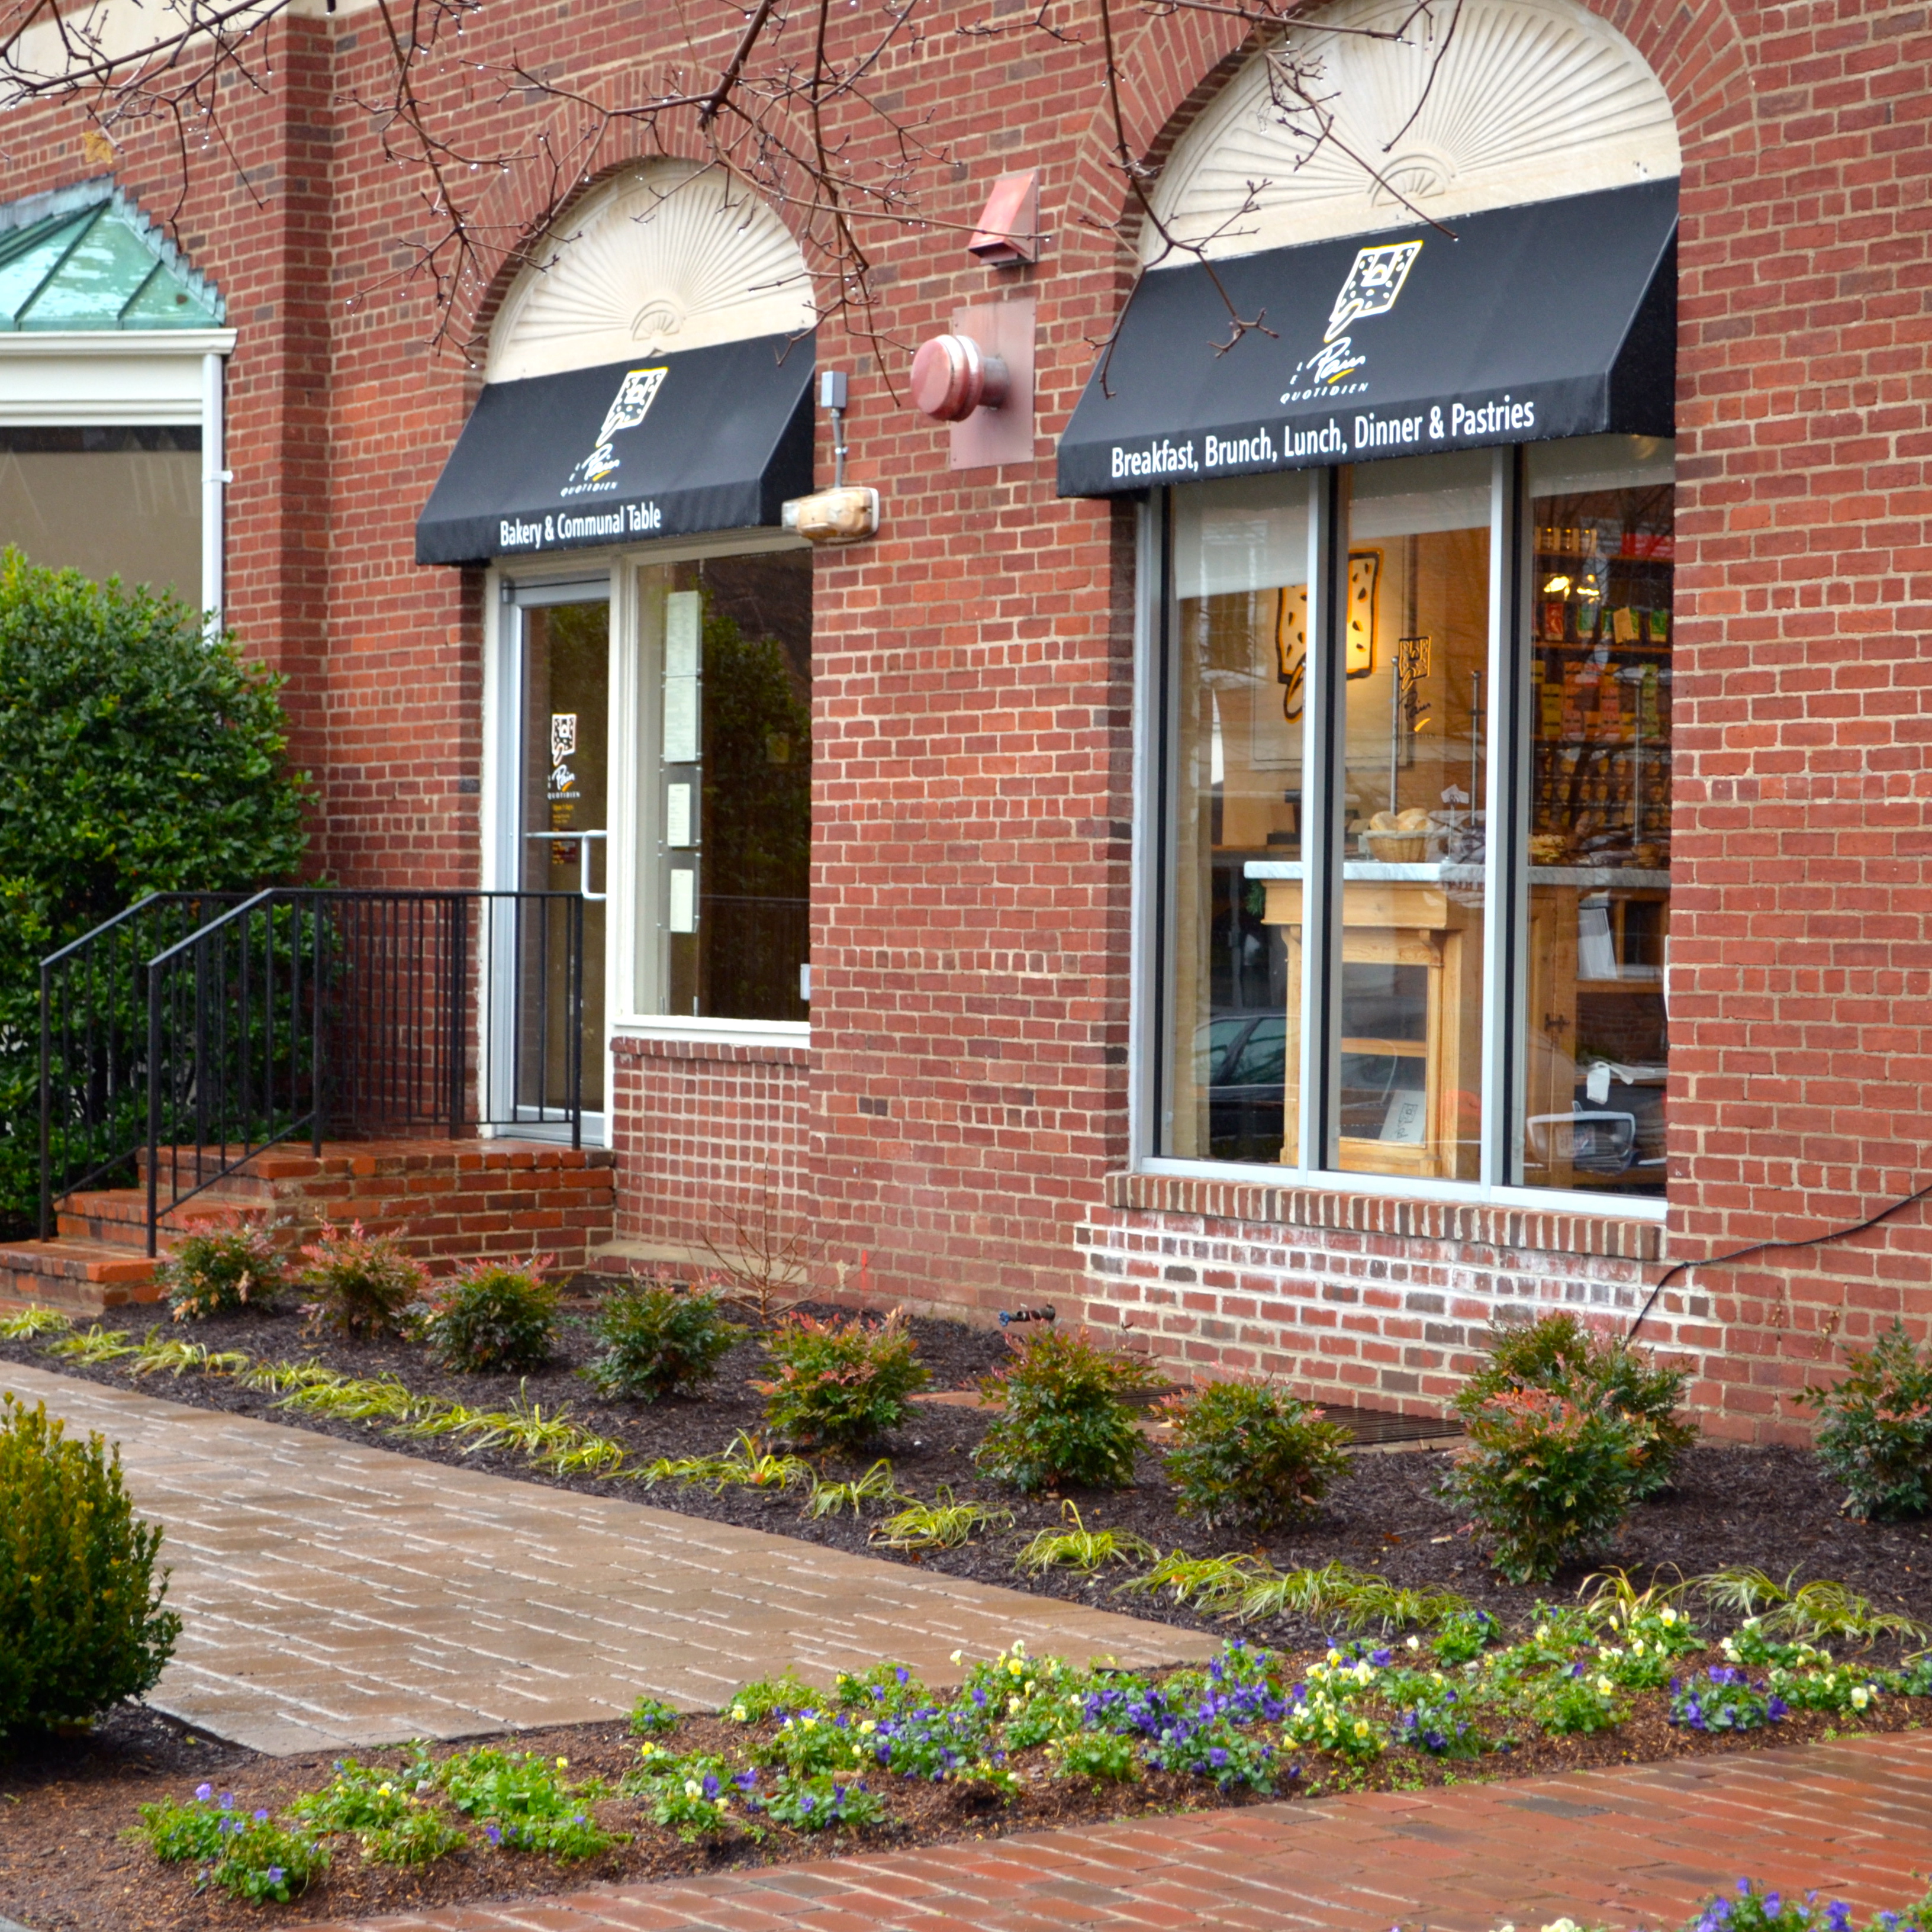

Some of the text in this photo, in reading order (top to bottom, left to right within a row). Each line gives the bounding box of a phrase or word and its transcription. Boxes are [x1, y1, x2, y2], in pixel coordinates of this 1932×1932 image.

[1306, 337, 1366, 384] Pain
[1280, 382, 1368, 404] QUOTIDIEN
[1112, 395, 1535, 478] Breakfast, Brunch, Lunch, Dinner & Pastries
[500, 501, 661, 549] Bakery & Communal Table
